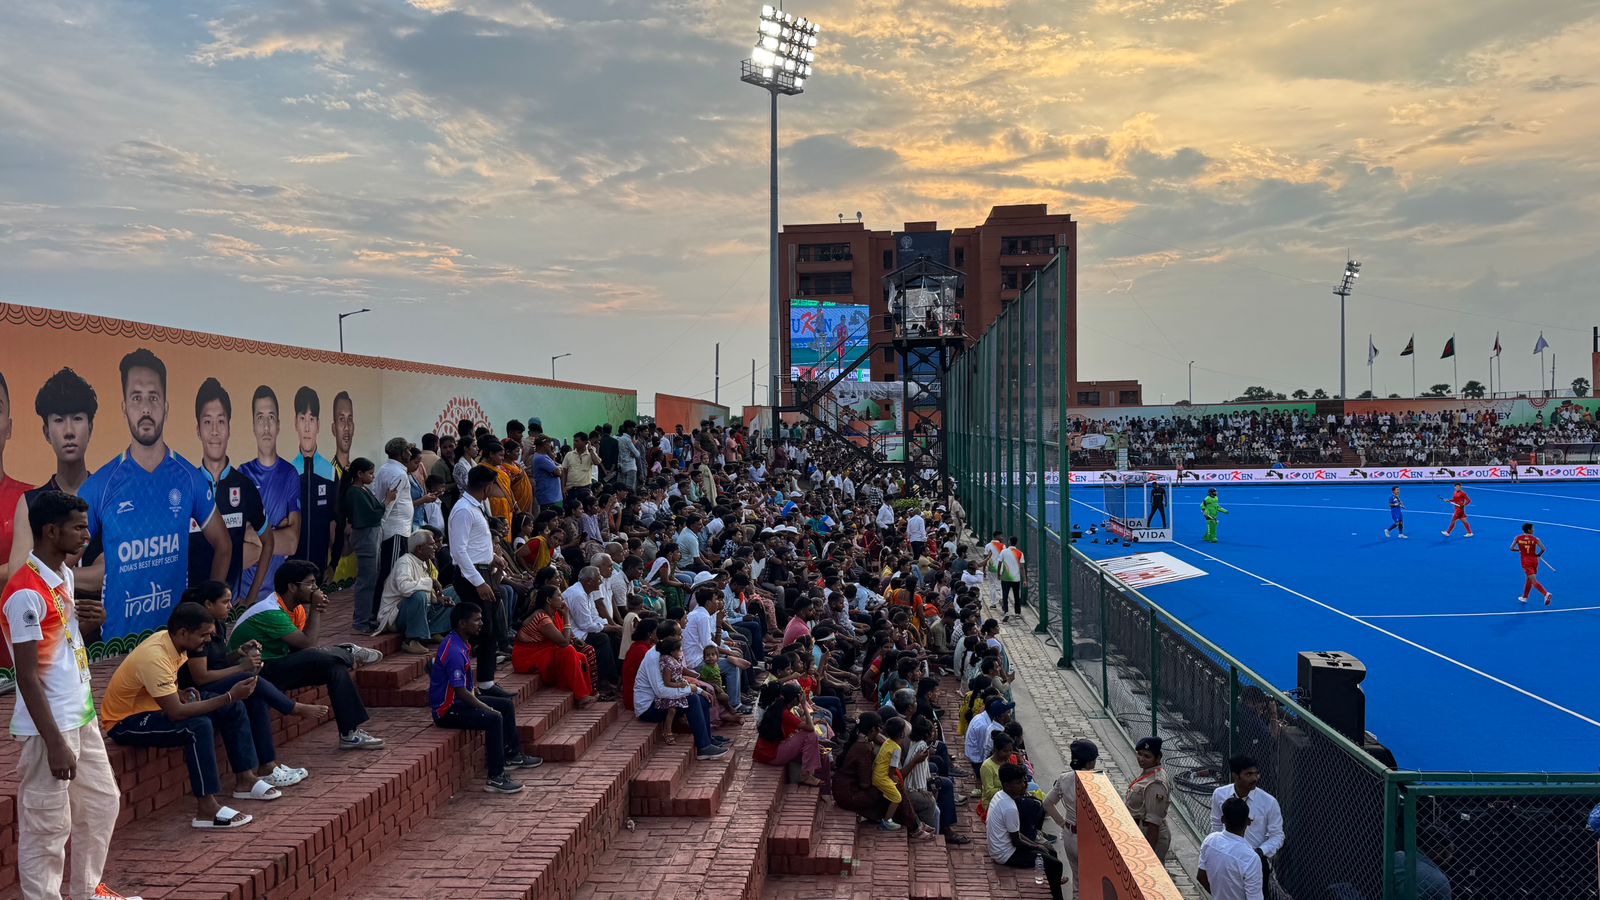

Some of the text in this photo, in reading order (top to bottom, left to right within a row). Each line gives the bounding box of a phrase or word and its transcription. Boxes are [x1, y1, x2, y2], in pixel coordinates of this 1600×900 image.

[1218, 471, 1253, 481] OUKEN
[1301, 470, 1337, 480] OUKEN
[1386, 469, 1423, 479] OUKEN
[1562, 466, 1599, 477] OUKEN
[1138, 531, 1166, 539] VIDA
[117, 533, 180, 563] ODISHA
[1524, 545, 1531, 554] 7
[138, 559, 151, 570] BEST
[151, 557, 164, 567] KEPT
[124, 581, 172, 618] india
